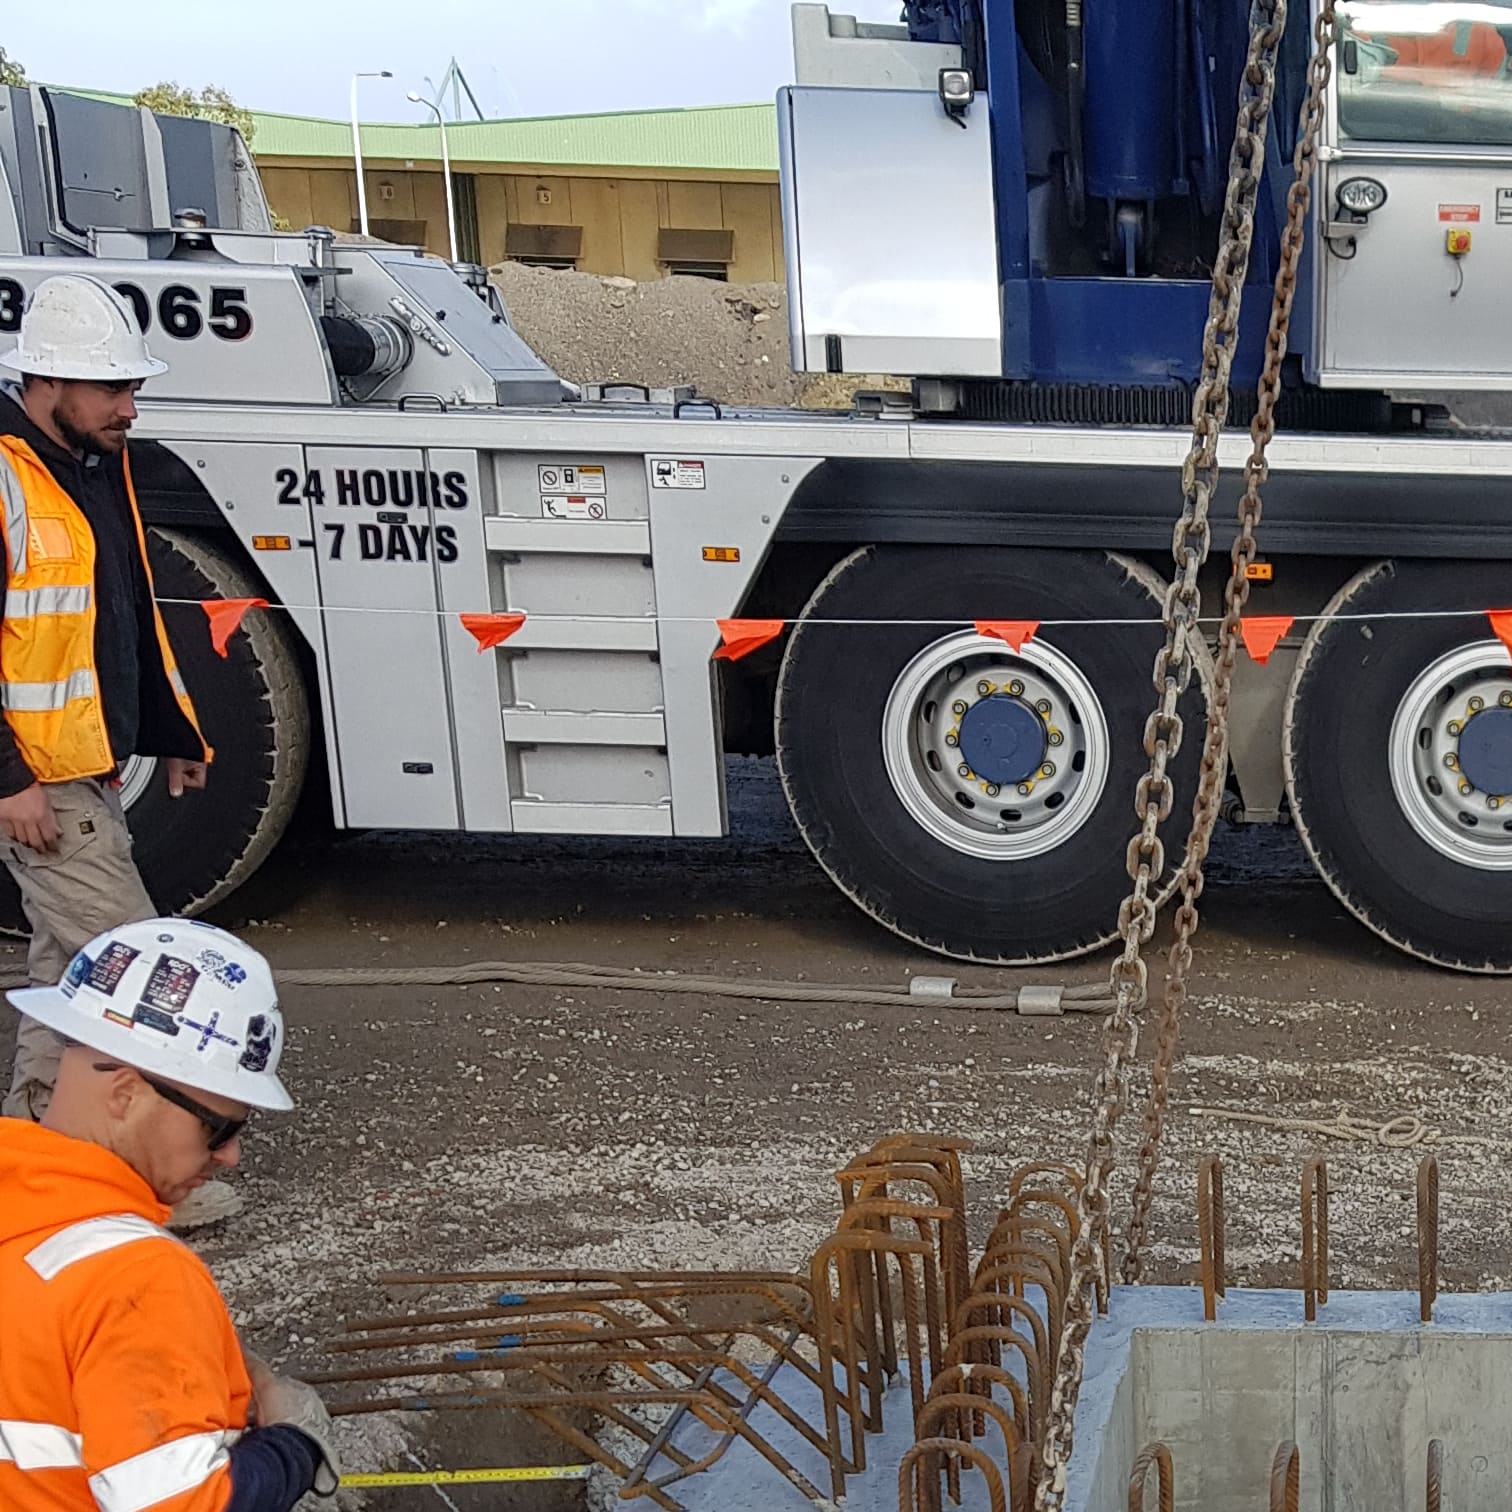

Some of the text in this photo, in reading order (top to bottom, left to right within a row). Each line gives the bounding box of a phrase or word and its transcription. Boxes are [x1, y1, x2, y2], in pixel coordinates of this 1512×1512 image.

[275, 468, 469, 509] 24 HOURS
[323, 522, 345, 560] 7
[358, 523, 460, 563] DAYS
